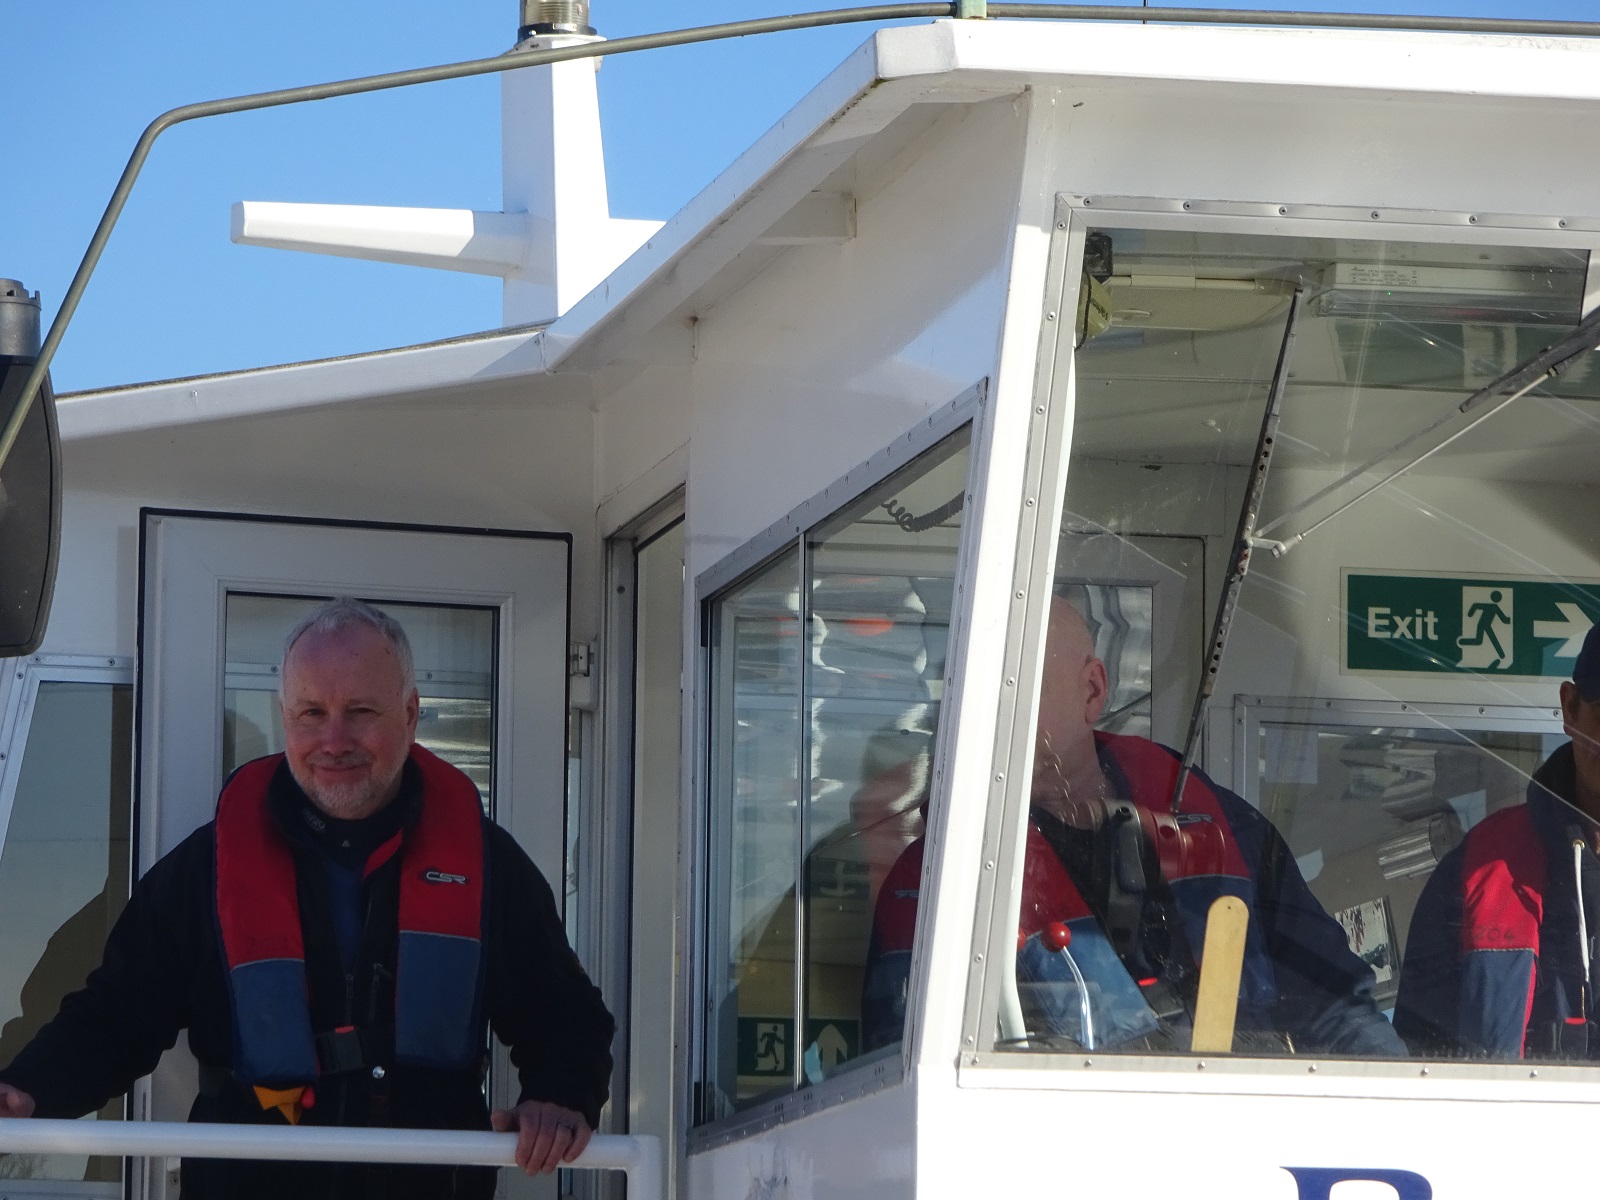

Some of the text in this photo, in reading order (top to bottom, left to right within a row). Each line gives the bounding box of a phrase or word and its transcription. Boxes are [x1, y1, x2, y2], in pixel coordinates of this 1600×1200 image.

[1367, 606, 1439, 641] Exit
[1175, 813, 1213, 824] CSR
[426, 871, 467, 885] CSR
